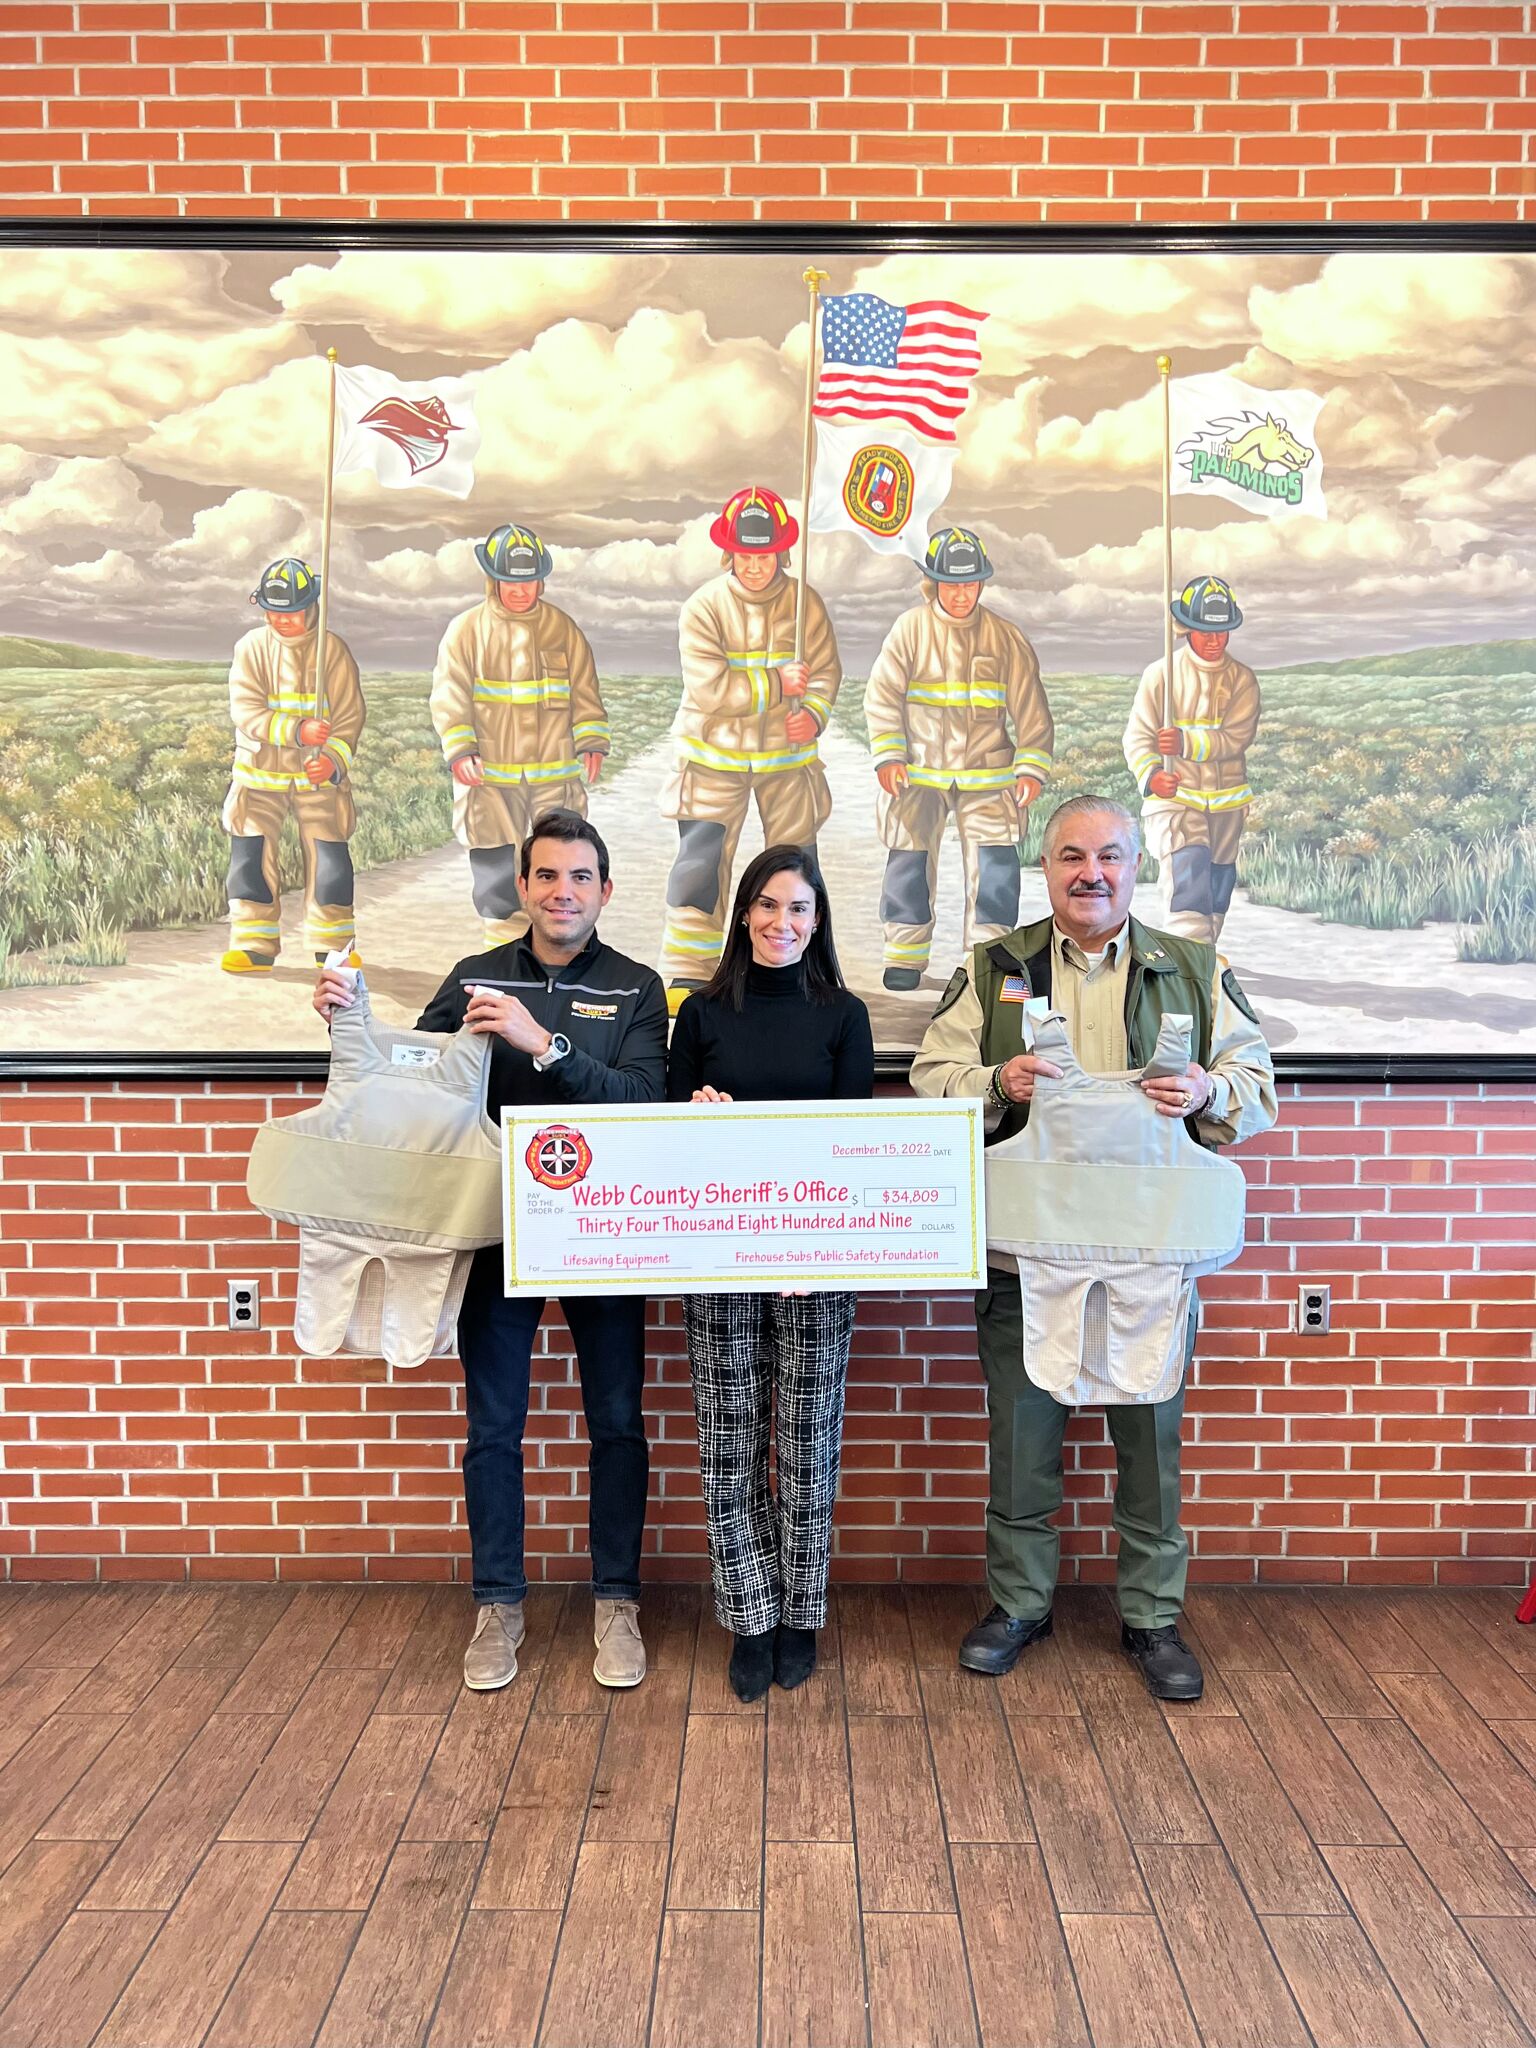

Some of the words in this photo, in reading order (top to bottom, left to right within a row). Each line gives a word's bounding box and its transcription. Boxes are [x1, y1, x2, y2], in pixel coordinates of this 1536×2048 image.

[858, 450, 881, 468] READY
[884, 452, 899, 463] FOR
[897, 463, 907, 484] DUTY
[1191, 449, 1303, 505] PALOMINOS
[538, 1128, 579, 1136] FIREHOUSE
[577, 1141, 587, 1171] SAFETY
[832, 1144, 880, 1156] December
[882, 1144, 899, 1155] 15,
[901, 1143, 931, 1154] 2022
[530, 1142, 539, 1174] PUBLIC
[541, 1175, 578, 1186] FOUNDATION
[572, 1184, 625, 1206] Webb
[630, 1183, 700, 1210] County
[705, 1180, 789, 1204] Sheriff's
[794, 1180, 849, 1203] Office
[852, 1194, 858, 1206] $
[882, 1189, 939, 1204] $34,809
[540, 1199, 554, 1207] THE
[527, 1207, 553, 1215] ORDER
[576, 1216, 623, 1237] Thirty
[626, 1216, 660, 1233] Four
[662, 1214, 734, 1232] Thousand
[738, 1214, 778, 1235] Eight
[781, 1212, 845, 1230] Hundred
[849, 1211, 876, 1229] and
[879, 1211, 912, 1228] Nine
[921, 1223, 955, 1231] DOLLARS
[563, 1253, 614, 1268] Lifesaving
[616, 1253, 671, 1269] Equipment
[735, 1250, 785, 1263] Firehouse
[786, 1250, 812, 1262] Subs
[814, 1250, 844, 1262] Public
[845, 1249, 881, 1263] Safety
[882, 1249, 939, 1261] Foundation
